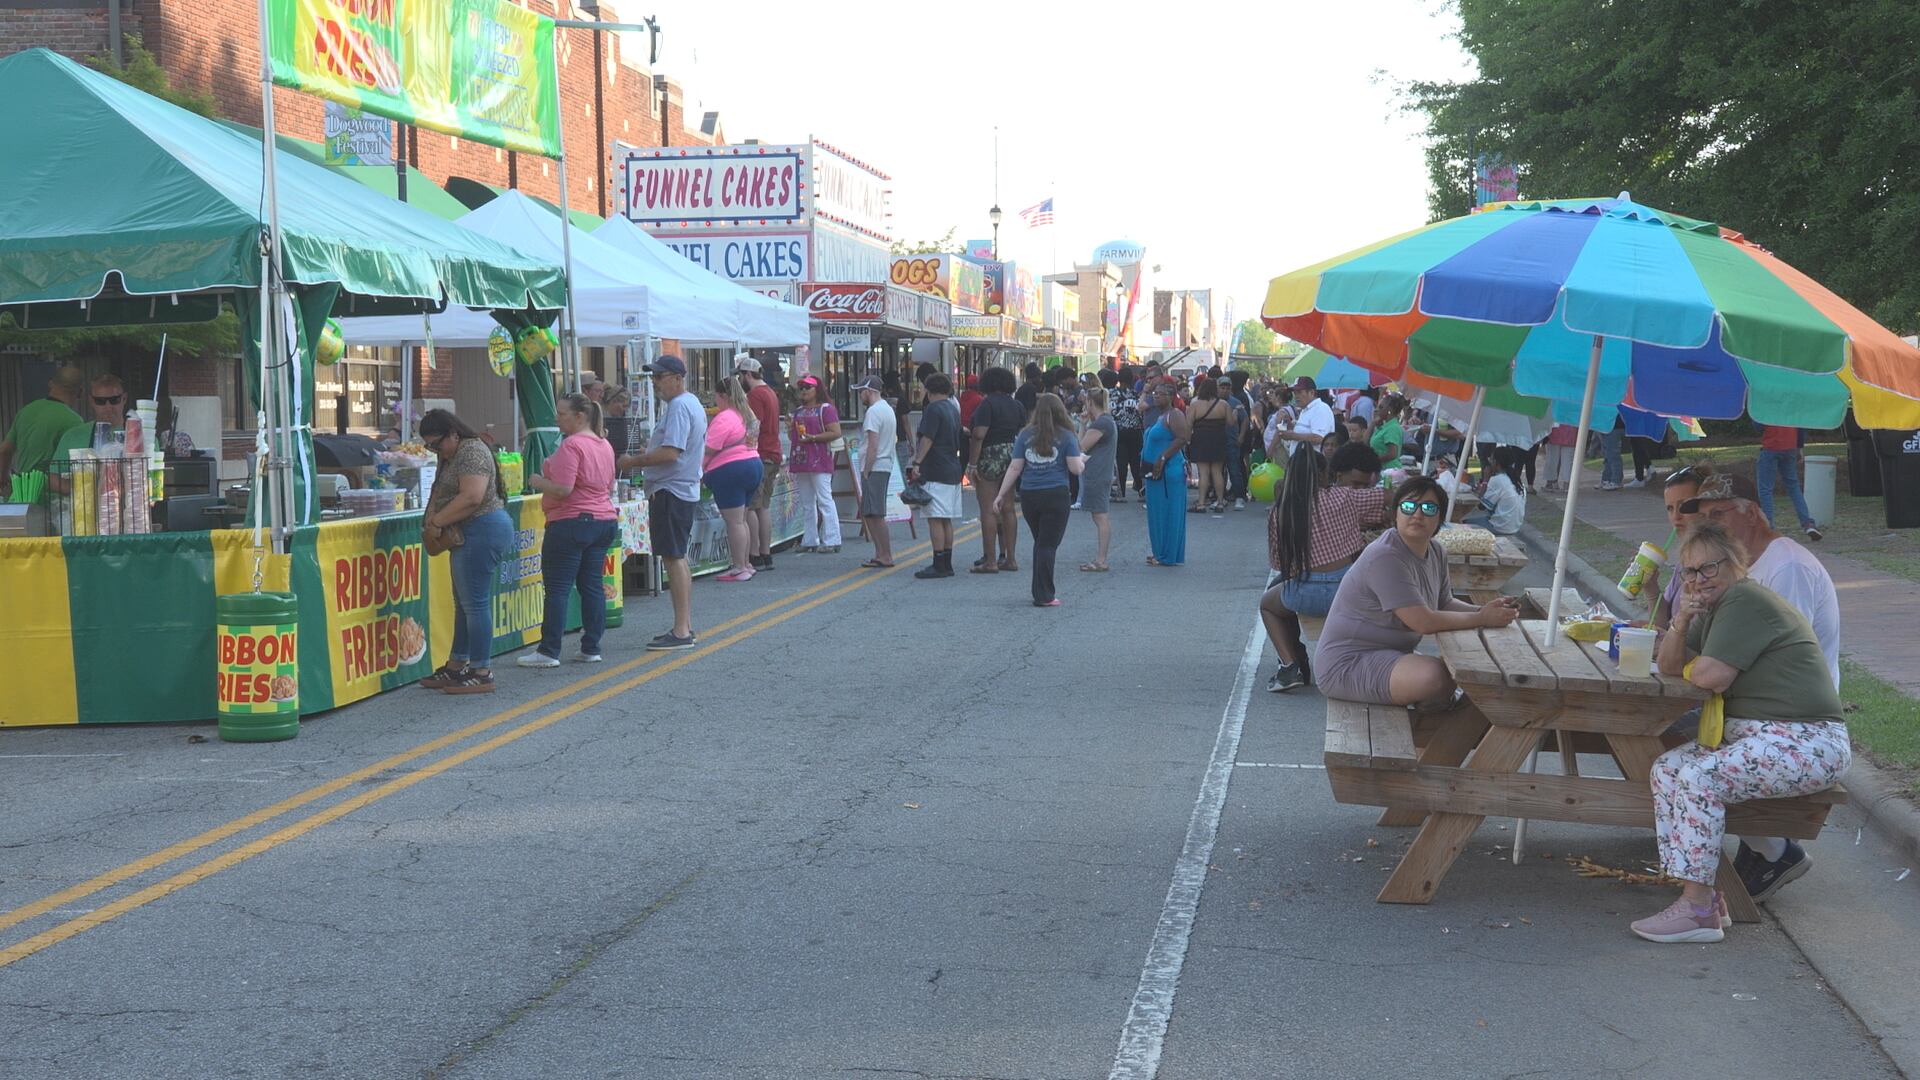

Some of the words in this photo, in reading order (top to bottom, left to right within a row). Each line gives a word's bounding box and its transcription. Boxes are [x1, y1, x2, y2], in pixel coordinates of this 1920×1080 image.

[327, 114, 388, 137] Dogwood
[336, 136, 384, 155] Festival
[632, 167, 713, 209] FUNNEL
[721, 164, 793, 209] CAKES
[724, 241, 803, 279] CAKES
[890, 258, 941, 285] OGS
[804, 287, 884, 314] Coca-Cola
[887, 290, 917, 325] FUNNEL
[923, 299, 949, 330] CAKES
[826, 326, 844, 335] DEEP
[847, 326, 869, 335] FRIED
[1903, 440, 1920, 450] GF
[513, 528, 535, 551] RESH
[335, 547, 420, 613] RIBBON
[493, 582, 544, 638] LEMONAD
[218, 632, 295, 666] IBBON
[342, 616, 399, 682] FRIES
[218, 671, 271, 704] RIES
